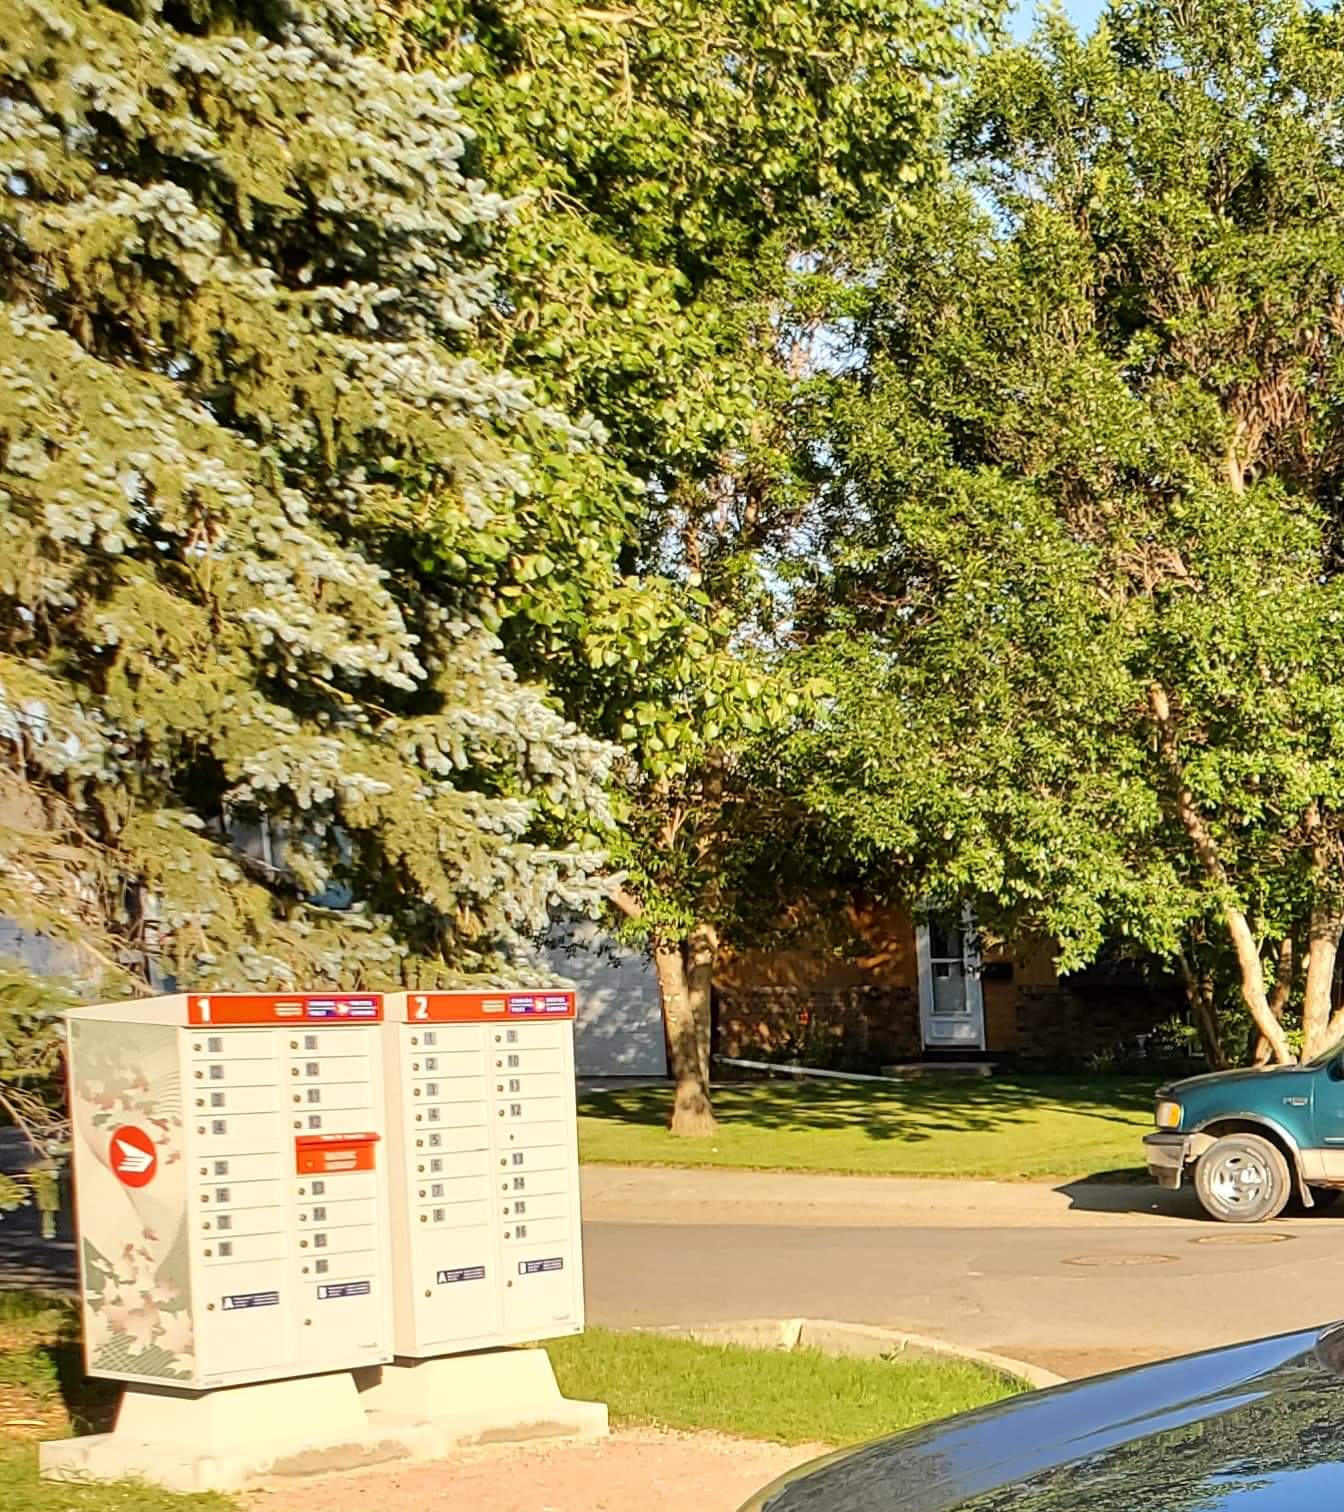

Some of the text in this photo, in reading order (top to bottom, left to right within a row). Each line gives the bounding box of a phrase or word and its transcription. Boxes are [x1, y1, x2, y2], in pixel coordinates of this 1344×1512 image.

[197, 999, 211, 1022] 1
[414, 996, 428, 1019] 2
[509, 1056, 519, 1065] 10
[511, 1104, 520, 1115] 12
[514, 1177, 524, 1190] 14
[515, 1202, 525, 1214] 15
[516, 1226, 526, 1239] 16
[438, 1271, 448, 1283] A
